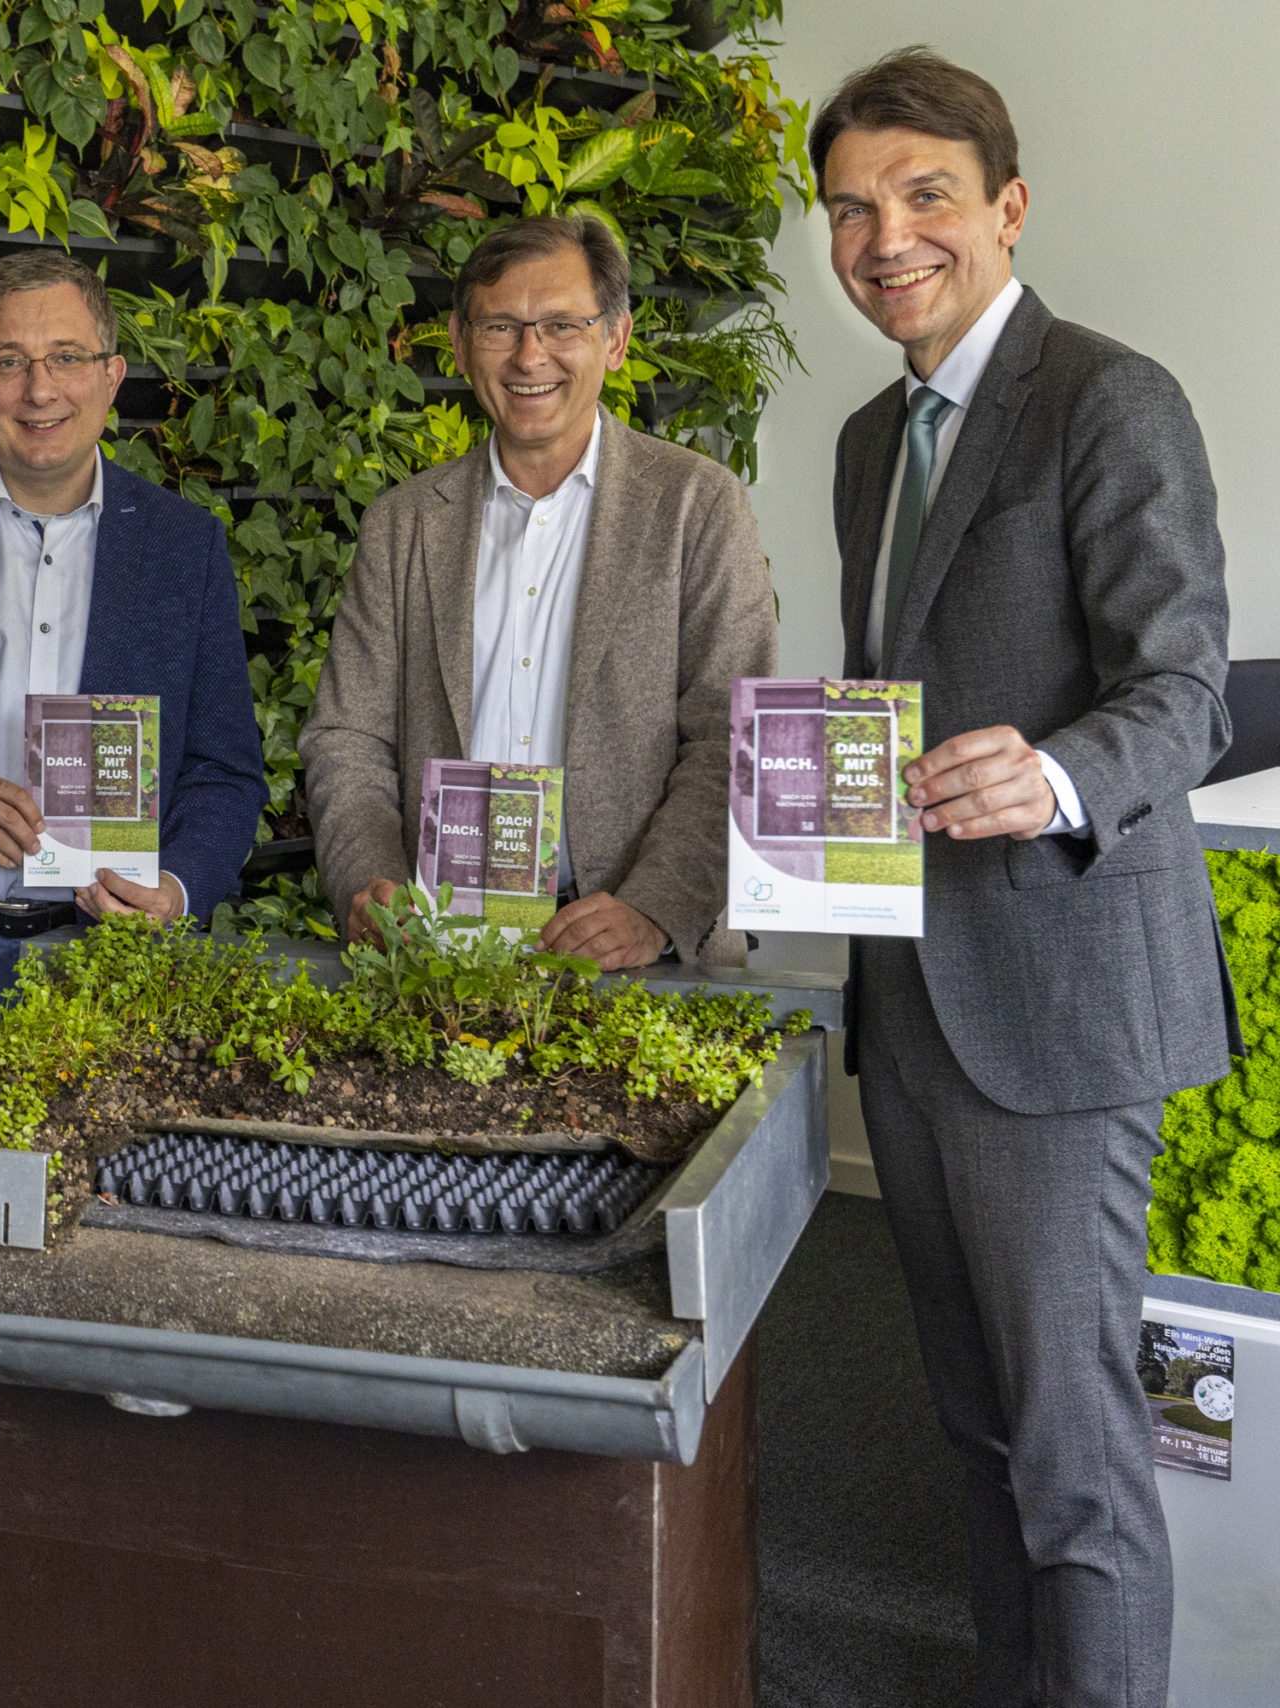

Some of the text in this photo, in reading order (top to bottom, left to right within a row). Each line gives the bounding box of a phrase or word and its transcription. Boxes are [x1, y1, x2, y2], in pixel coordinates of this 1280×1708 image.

[99, 746, 132, 755] DACH
[835, 743, 884, 755] DACH
[47, 757, 86, 766] DACH.
[105, 758, 126, 767] MIT
[761, 758, 818, 770] DACH.
[844, 758, 874, 771] MIT
[99, 770, 132, 779] PLUS.
[835, 774, 883, 786] PLUS.
[496, 815, 532, 826] DACH
[442, 824, 483, 836] DACH.
[502, 828, 525, 839] MIT
[495, 841, 530, 852] PLUS.
[1164, 1328, 1179, 1338] Ein
[1153, 1342, 1231, 1364] Haus-Berge-Park
[1213, 1346, 1231, 1356] den
[1160, 1435, 1173, 1445] Fr.
[1181, 1440, 1194, 1450] 13.
[1196, 1444, 1228, 1456] Januar
[1199, 1452, 1209, 1460] 16
[1210, 1455, 1228, 1465] Uhr
